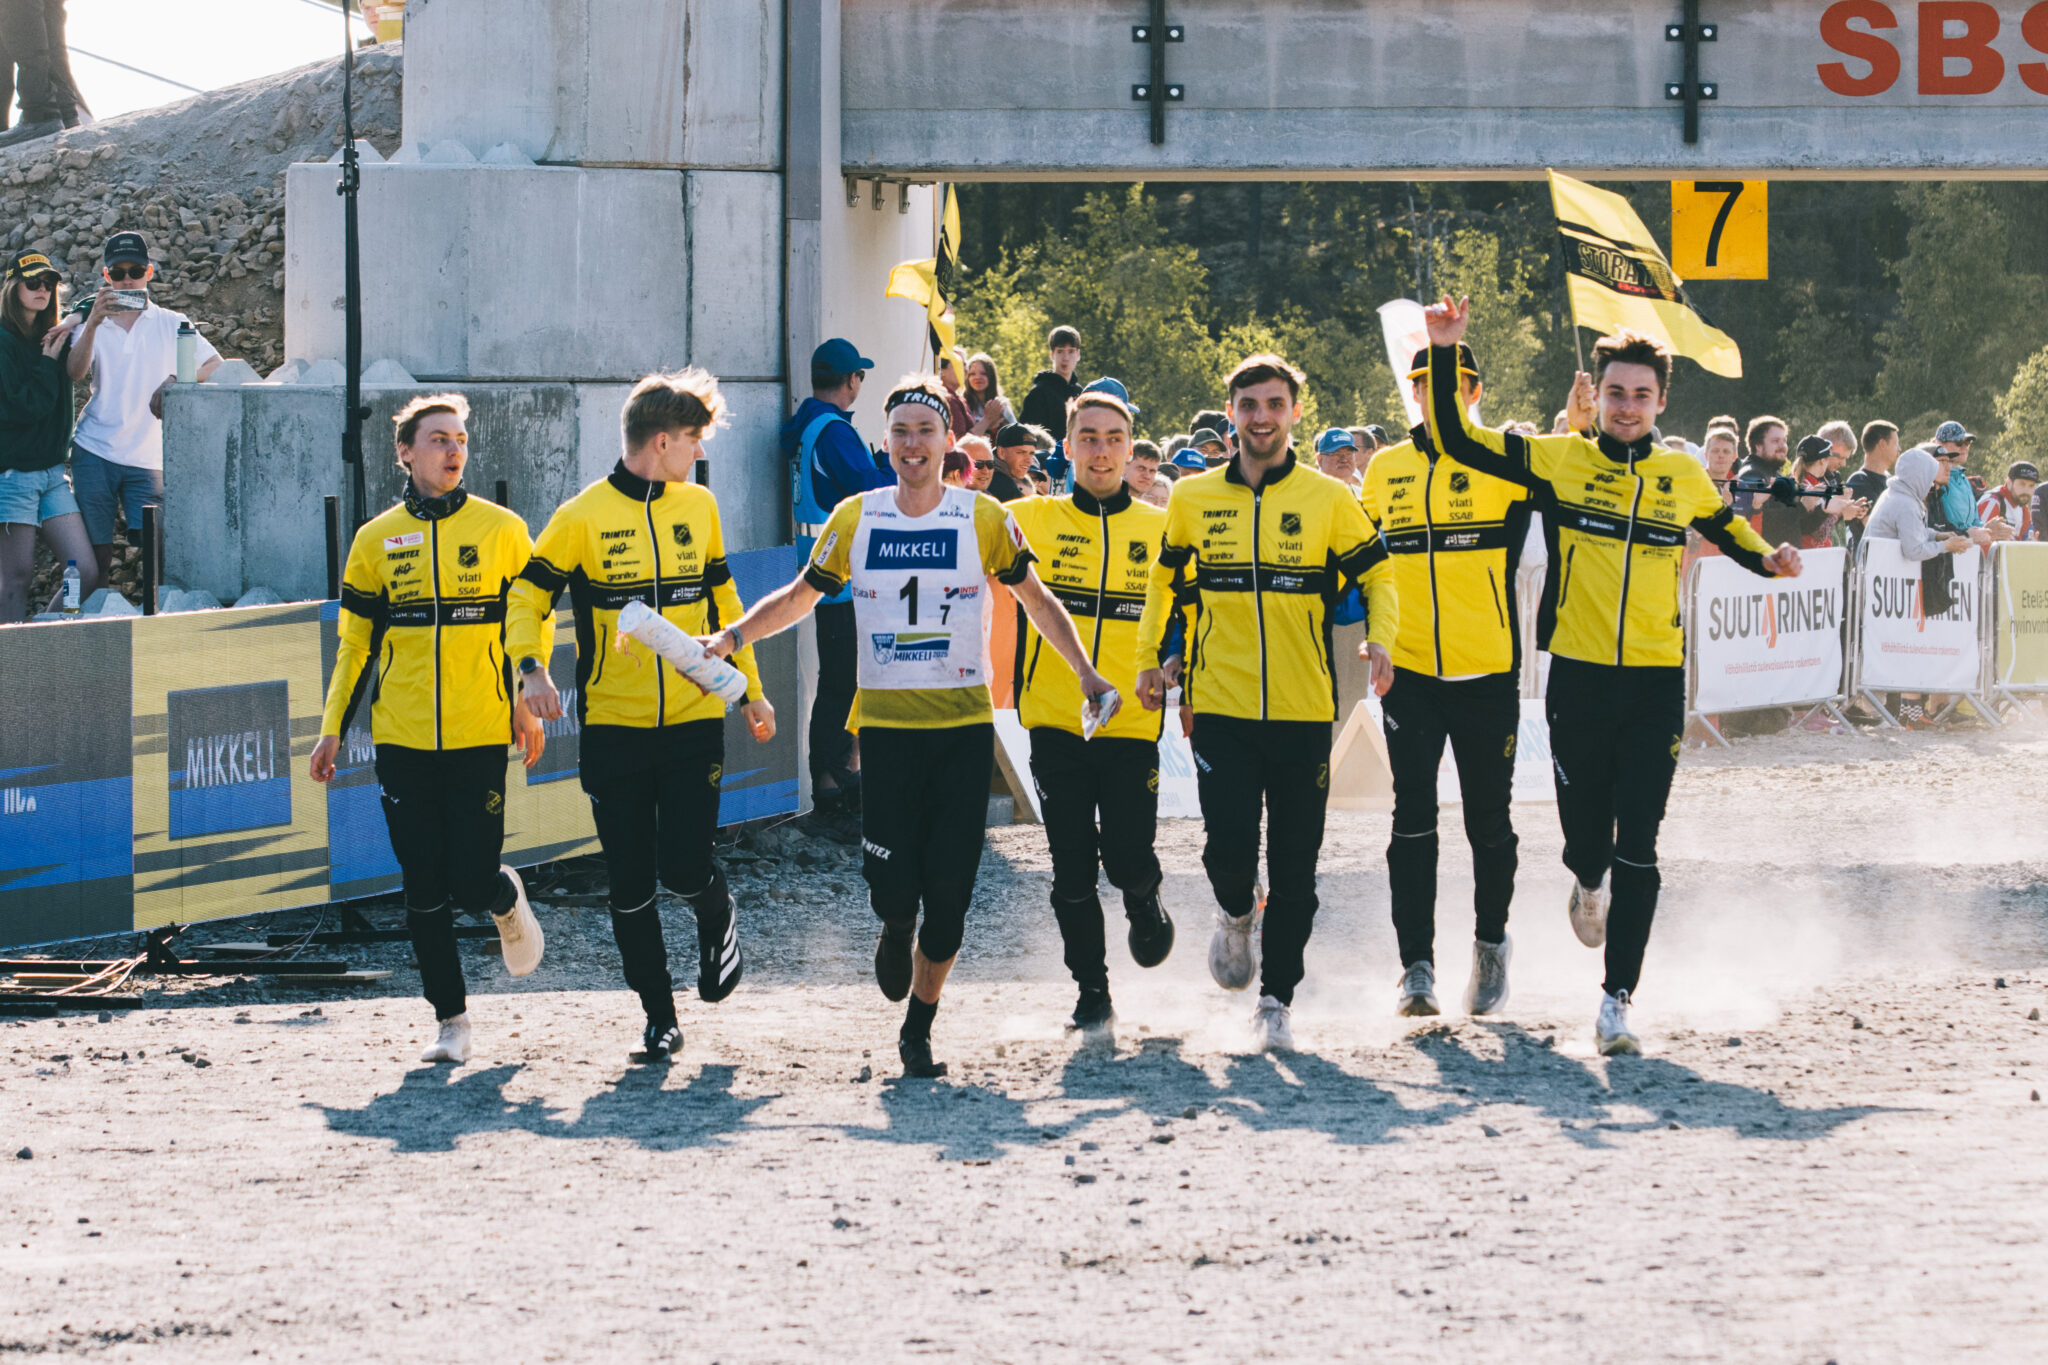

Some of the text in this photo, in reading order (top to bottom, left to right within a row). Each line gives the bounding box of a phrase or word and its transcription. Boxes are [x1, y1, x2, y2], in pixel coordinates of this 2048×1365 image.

[1694, 181, 1744, 267] 7
[1448, 498, 1473, 508] viati
[1203, 510, 1238, 518] TRIMTEX
[1448, 511, 1474, 521] SSAB
[600, 529, 636, 540] TRIMTEX
[1056, 534, 1091, 544] TRIMTEX
[879, 542, 947, 558] MIKKELI
[1278, 540, 1303, 551] viati
[387, 550, 420, 561] TRIMTEX
[677, 551, 697, 561] viati
[1278, 554, 1302, 564] SSAB
[678, 565, 698, 574] SSAB
[457, 573, 482, 582] viati
[457, 586, 481, 595] SSAB
[900, 576, 918, 625] 1
[1872, 575, 1972, 632] SUUTAEN
[940, 605, 951, 625] 7
[894, 651, 932, 661] MIKKELI
[186, 729, 275, 788] MIKKELI
